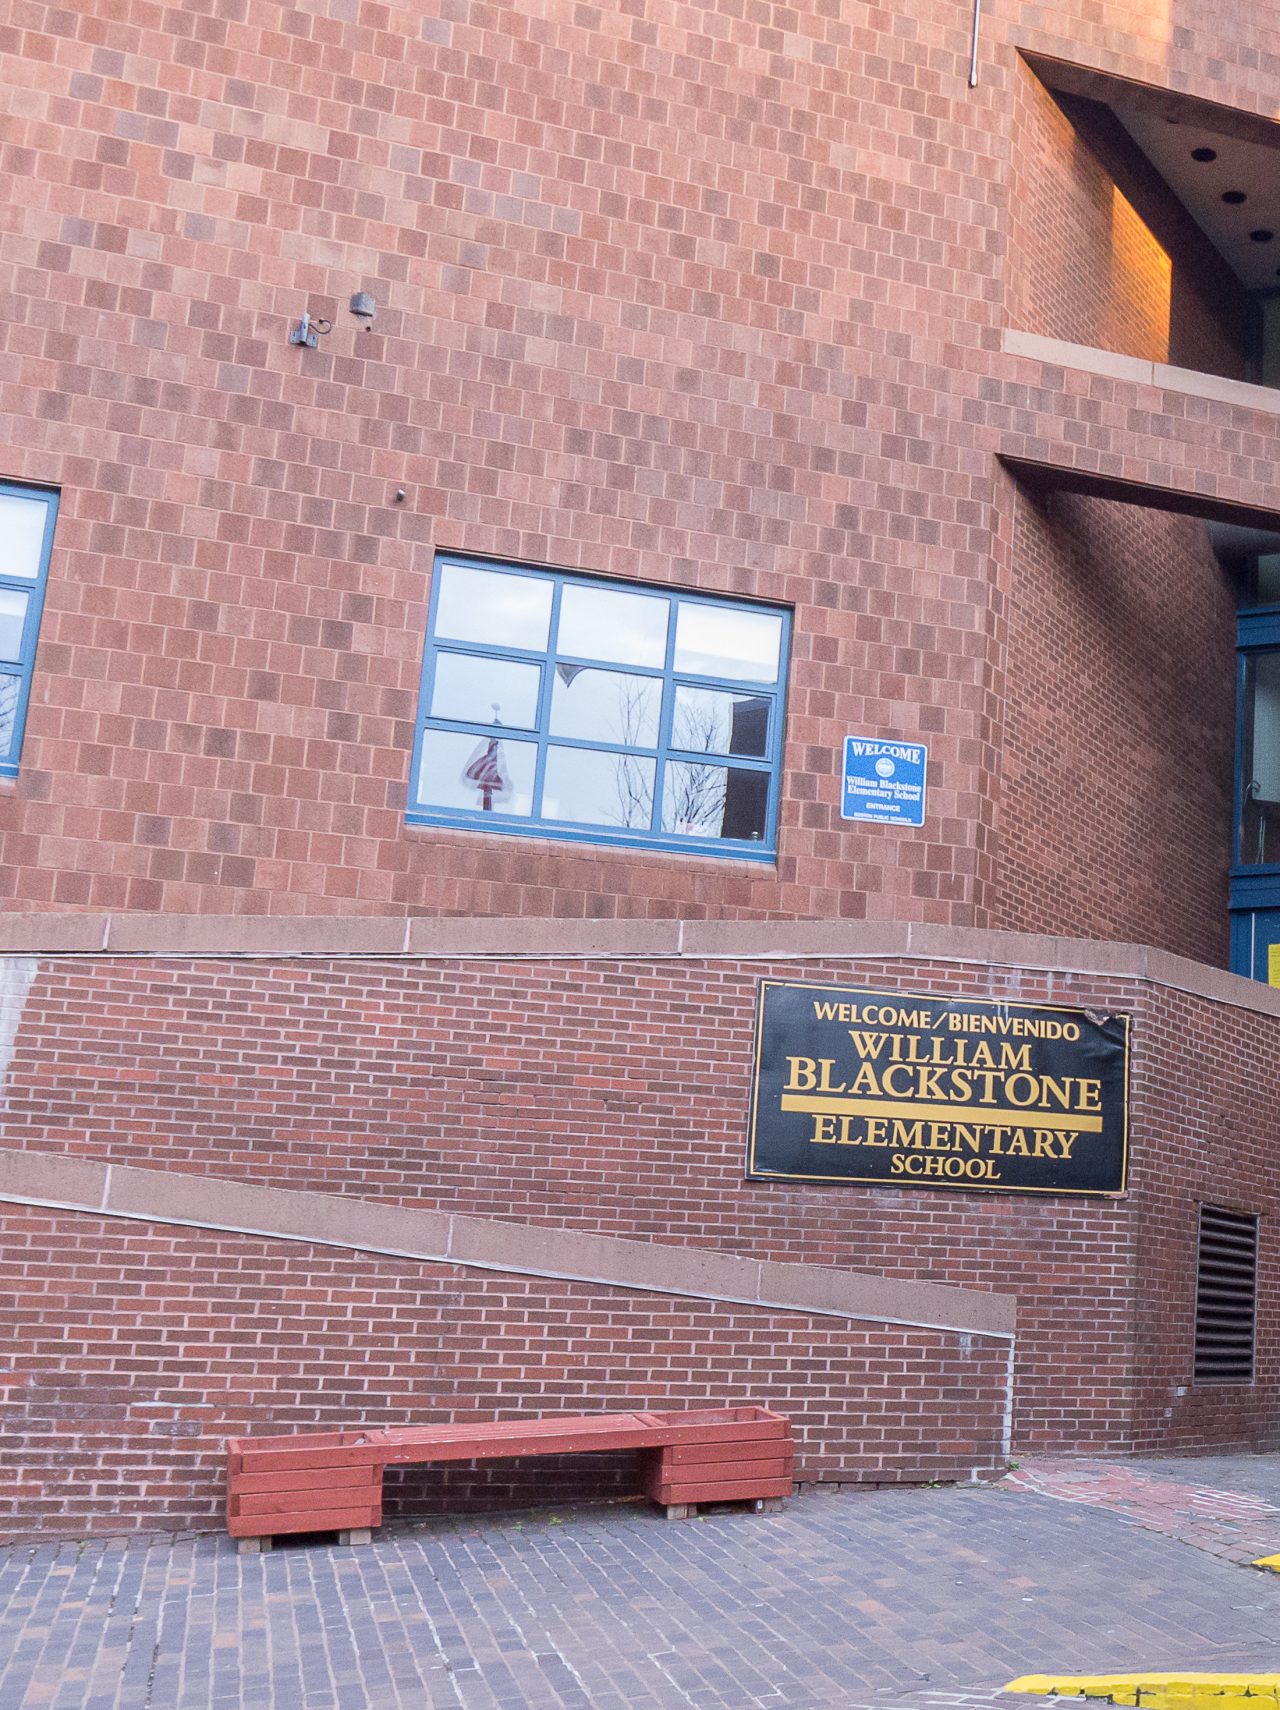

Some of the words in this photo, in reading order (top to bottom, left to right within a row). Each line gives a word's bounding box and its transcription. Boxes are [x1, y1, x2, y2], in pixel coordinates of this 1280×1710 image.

[852, 742, 920, 764] WELCOME
[847, 776, 878, 787] William
[848, 785, 892, 799] Elementary
[894, 790, 920, 801] School
[848, 1031, 1032, 1071] WILLIAM
[783, 1056, 1103, 1111] BLACKSTONE
[810, 1114, 1079, 1159] ELEMENTARY
[890, 1153, 1001, 1179] SCHOOL
